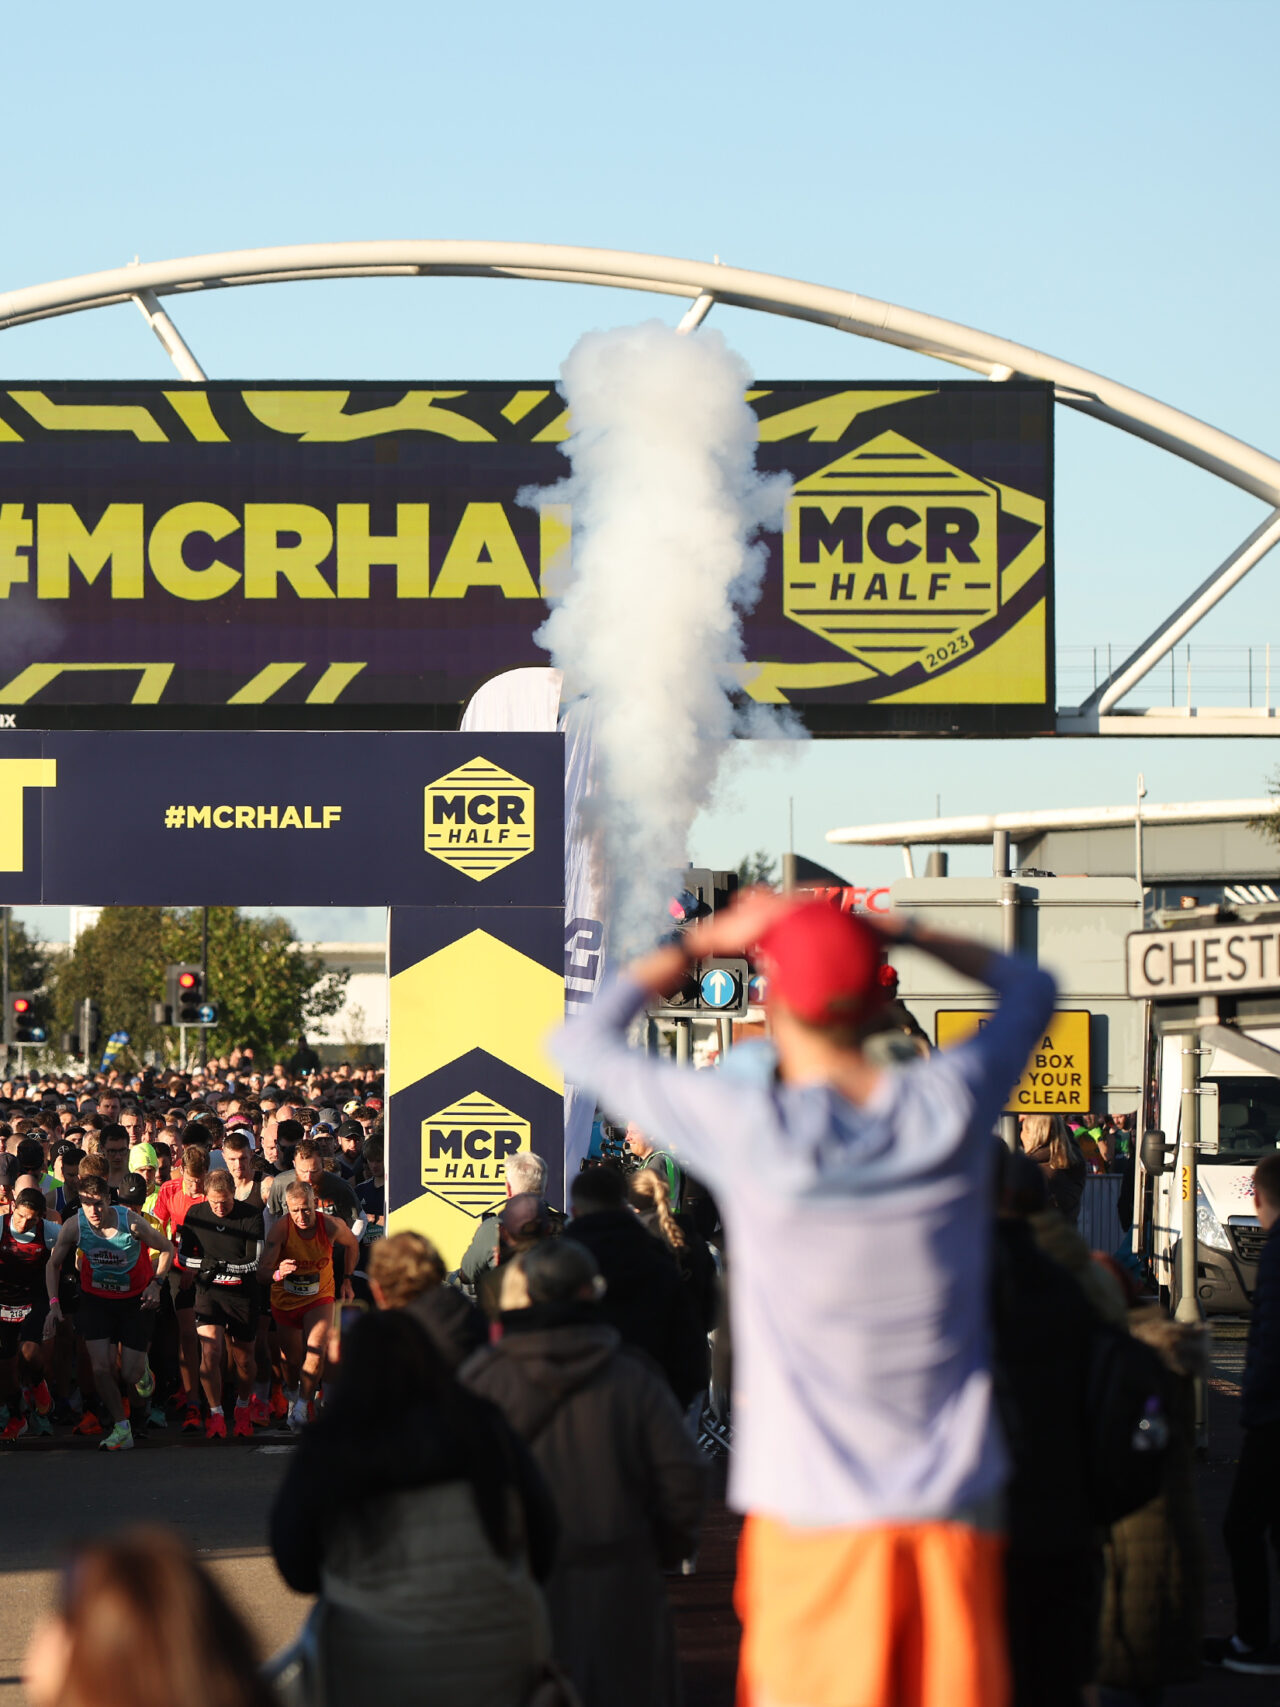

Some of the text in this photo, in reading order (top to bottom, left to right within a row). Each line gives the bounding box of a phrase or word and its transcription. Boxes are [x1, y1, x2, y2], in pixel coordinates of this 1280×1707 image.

[799, 505, 981, 565] MCR
[830, 573, 951, 601] HALF
[926, 634, 969, 668] 2023
[165, 805, 343, 829] #MCRHALF
[433, 795, 525, 825] MCR
[449, 828, 511, 844] HALF
[1143, 933, 1280, 986] CHEST
[1041, 1036, 1054, 1050] A
[1035, 1054, 1075, 1069] BOX
[1028, 1072, 1082, 1087] YOUR
[1018, 1090, 1081, 1105] CLEAR
[429, 1129, 522, 1160] MCR
[445, 1163, 505, 1179] HALF
